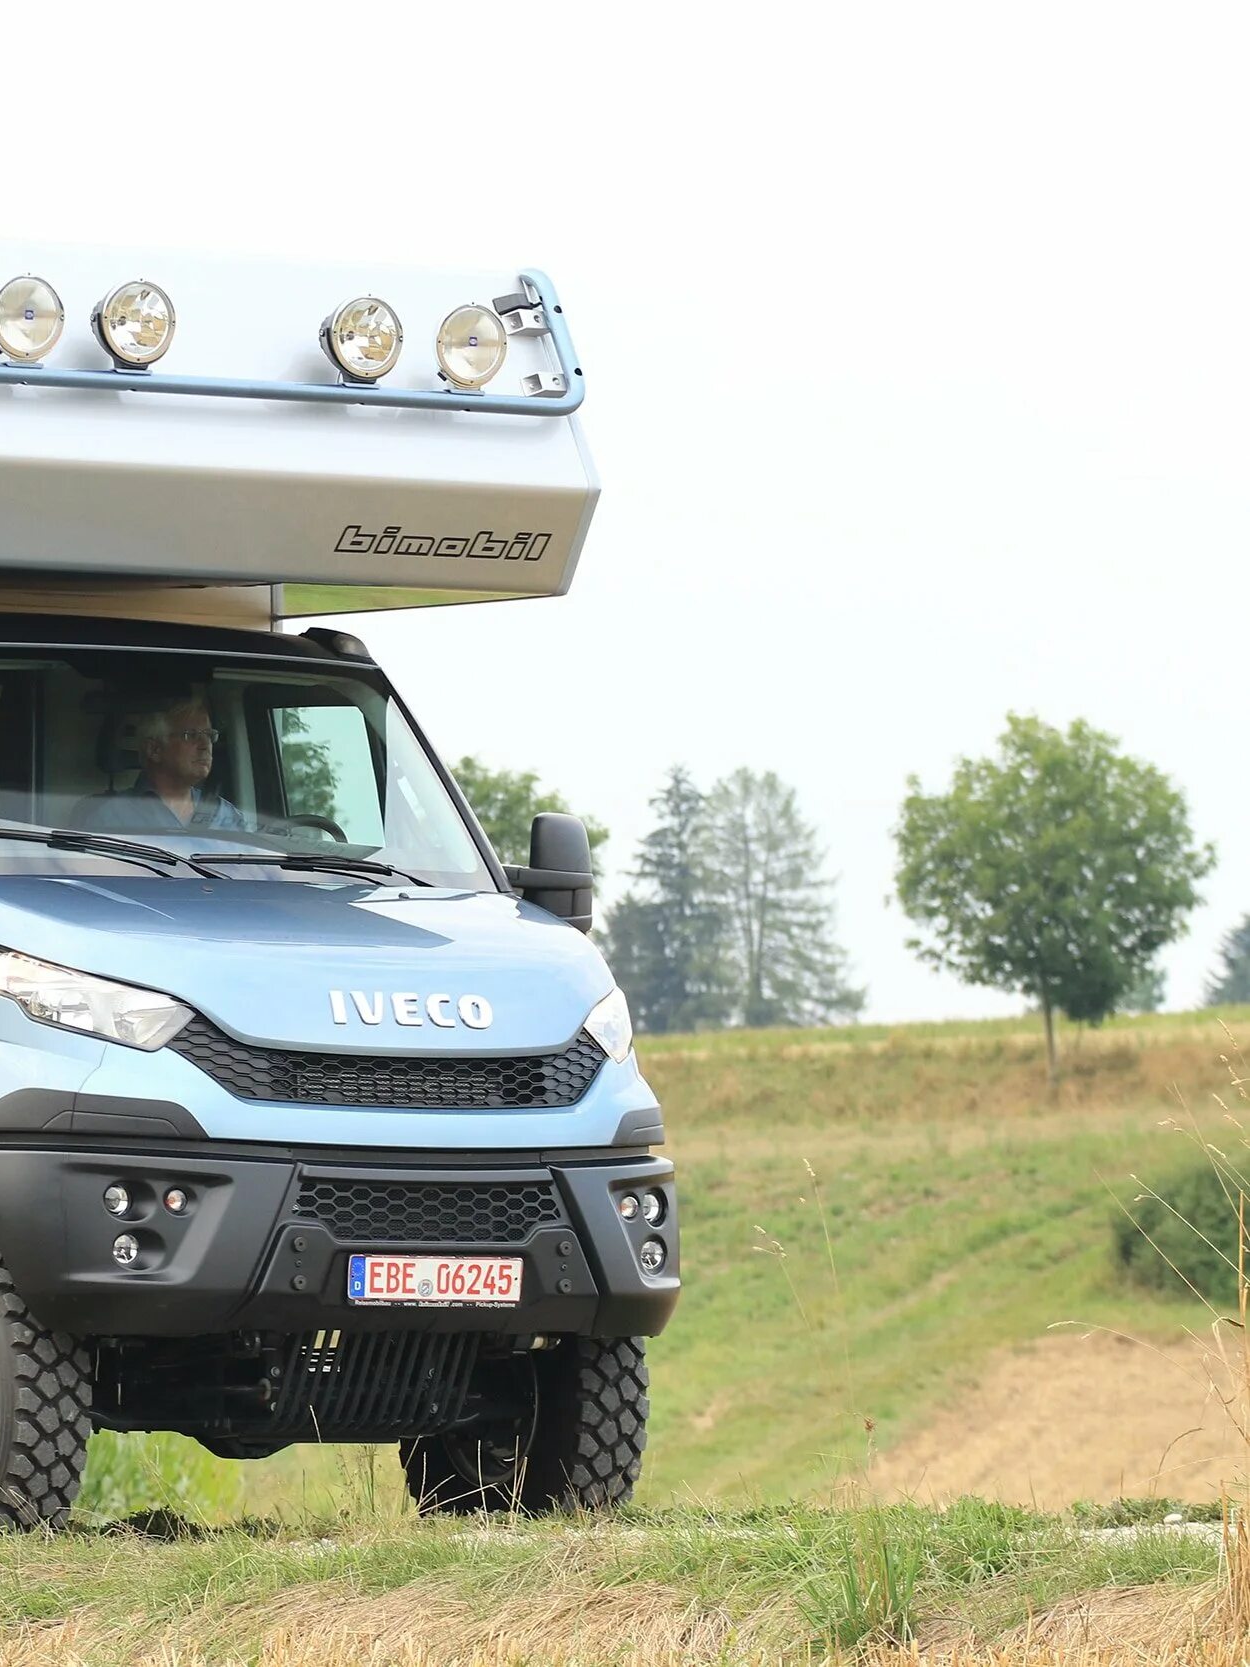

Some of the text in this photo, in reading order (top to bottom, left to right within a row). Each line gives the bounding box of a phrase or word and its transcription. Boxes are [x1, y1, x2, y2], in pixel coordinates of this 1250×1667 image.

[333, 525, 553, 561] bimobil
[328, 990, 494, 1030] IVECO
[354, 1281, 361, 1291] D
[369, 1262, 513, 1296] EBE 06245
